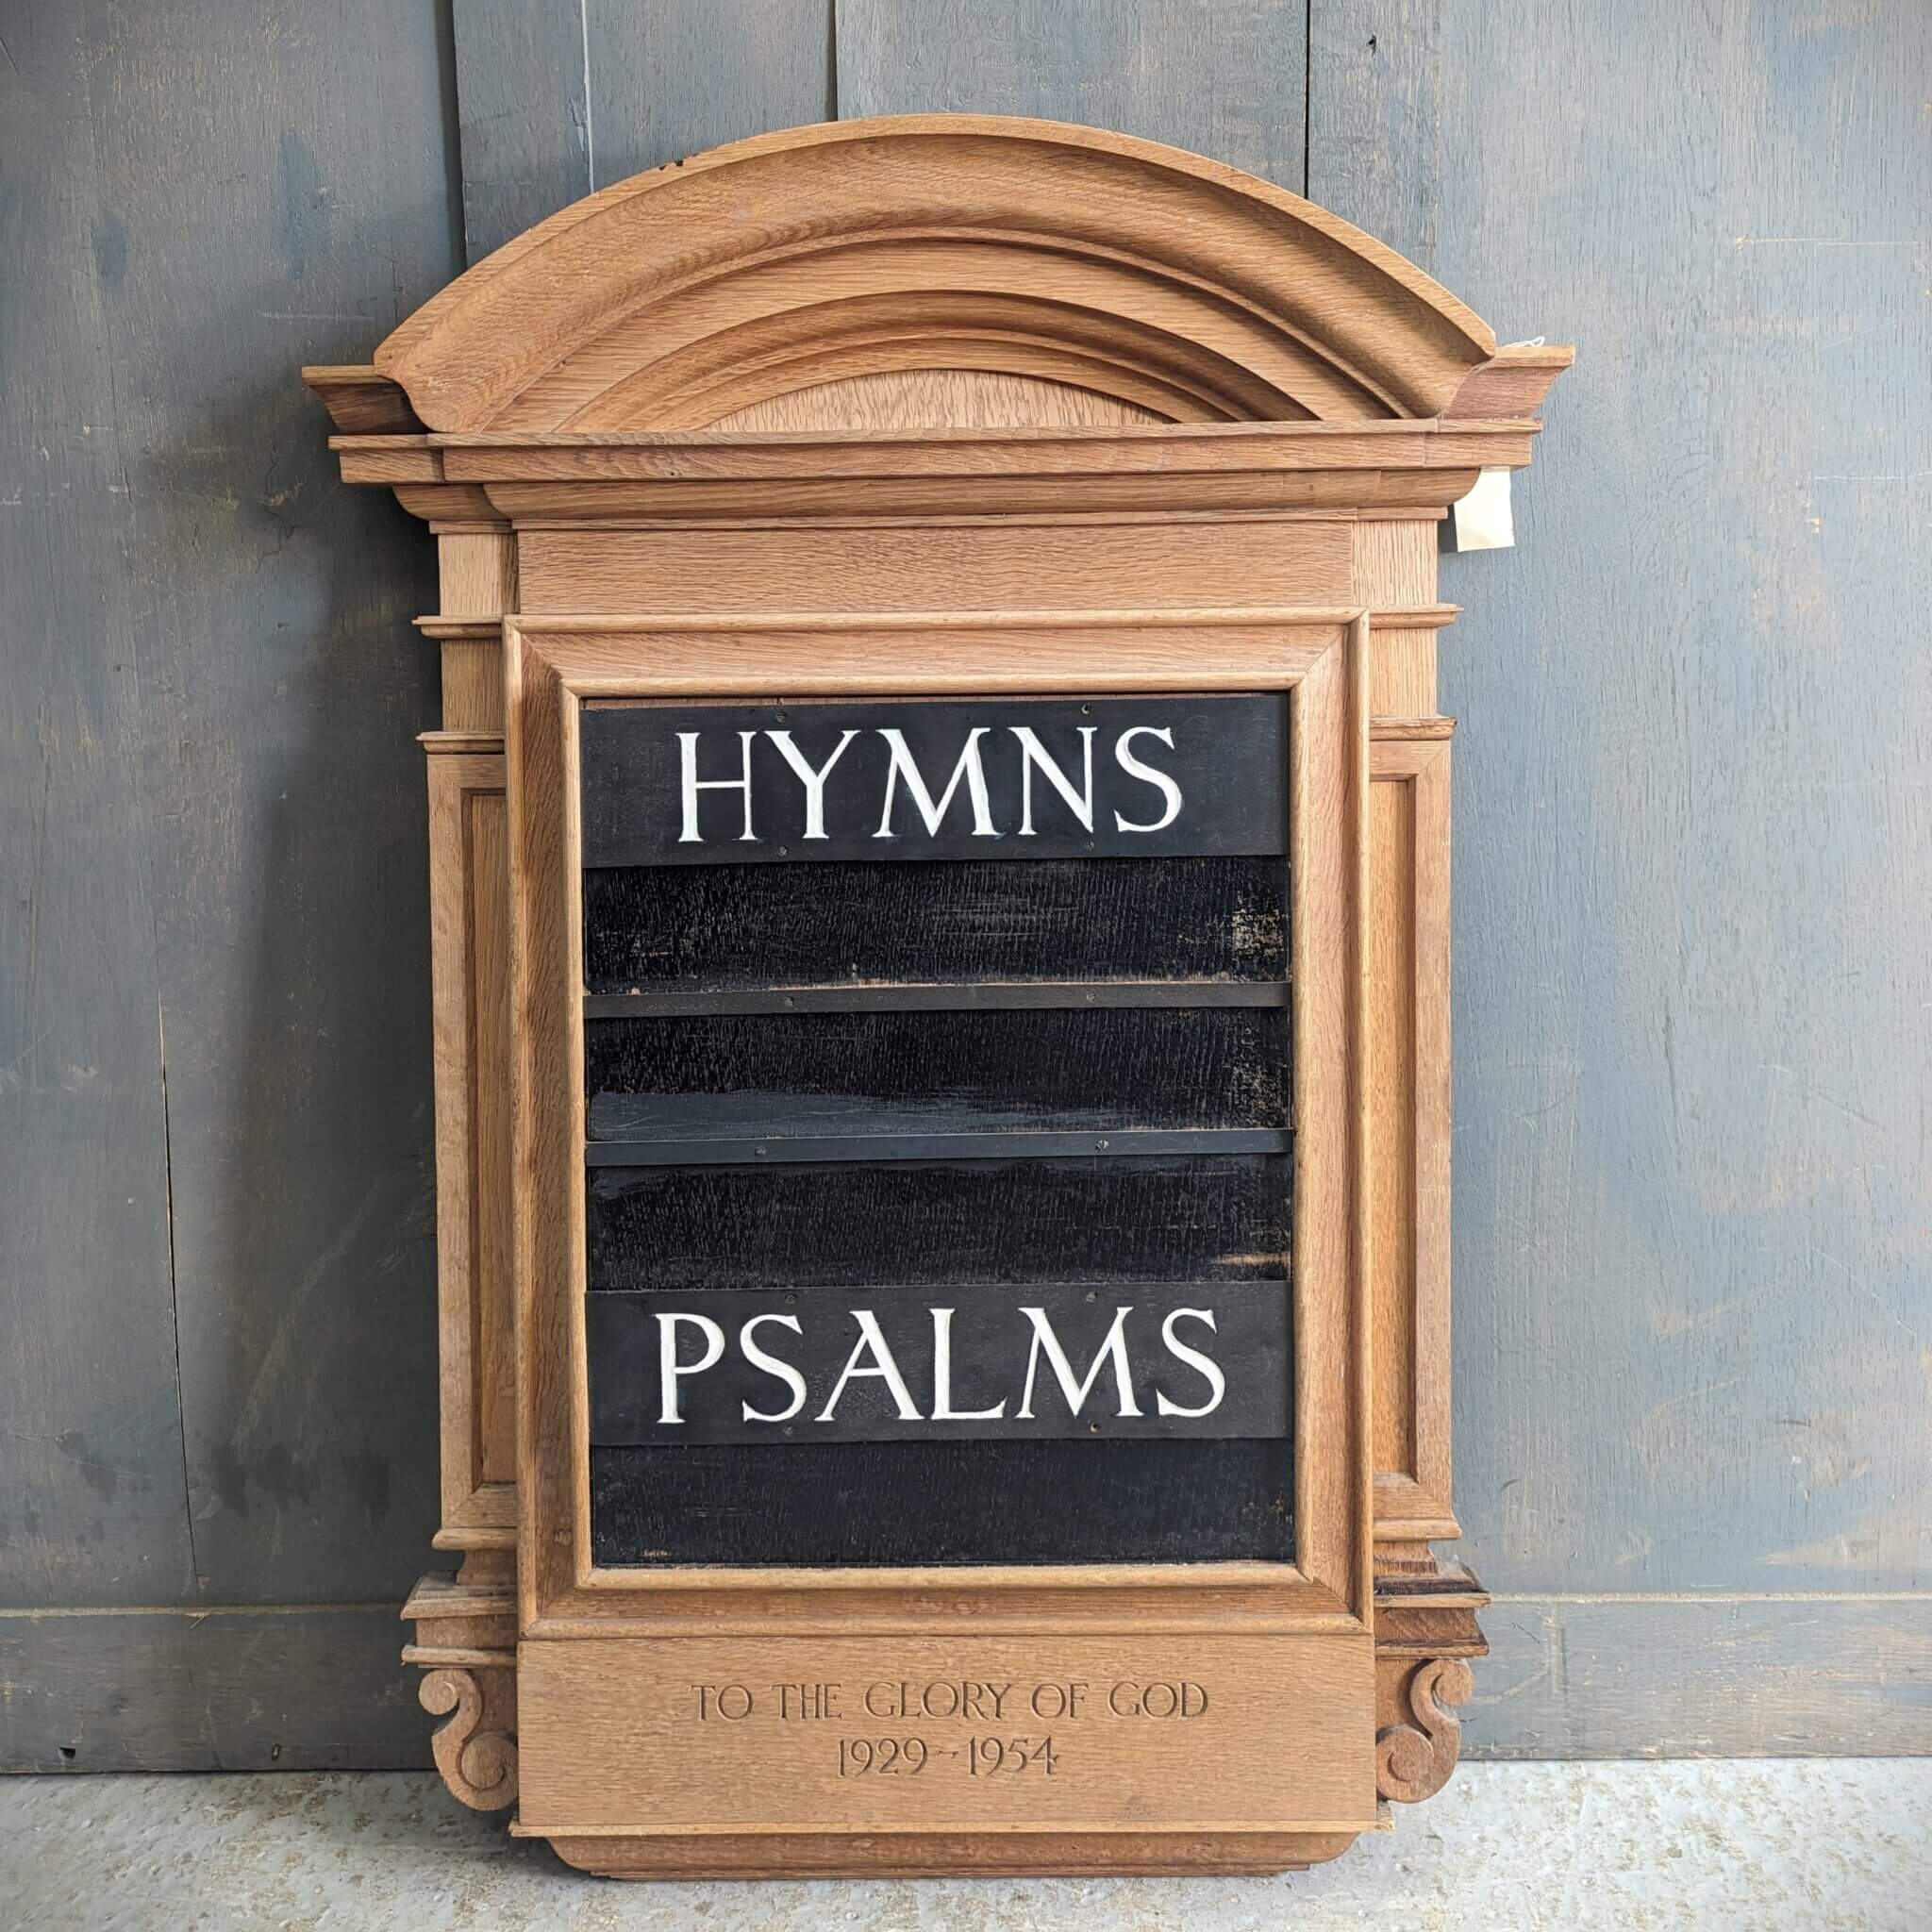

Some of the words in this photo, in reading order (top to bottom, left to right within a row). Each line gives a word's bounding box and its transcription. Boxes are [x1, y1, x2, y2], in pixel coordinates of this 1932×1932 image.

[675, 725, 1183, 843] HYMNS
[655, 1306, 1226, 1424] PSALMS
[690, 1683, 754, 1721] TO
[771, 1682, 843, 1721] THE
[862, 1680, 1013, 1721] GLORY
[1029, 1681, 1090, 1720] OF
[1107, 1680, 1209, 1720] GOD
